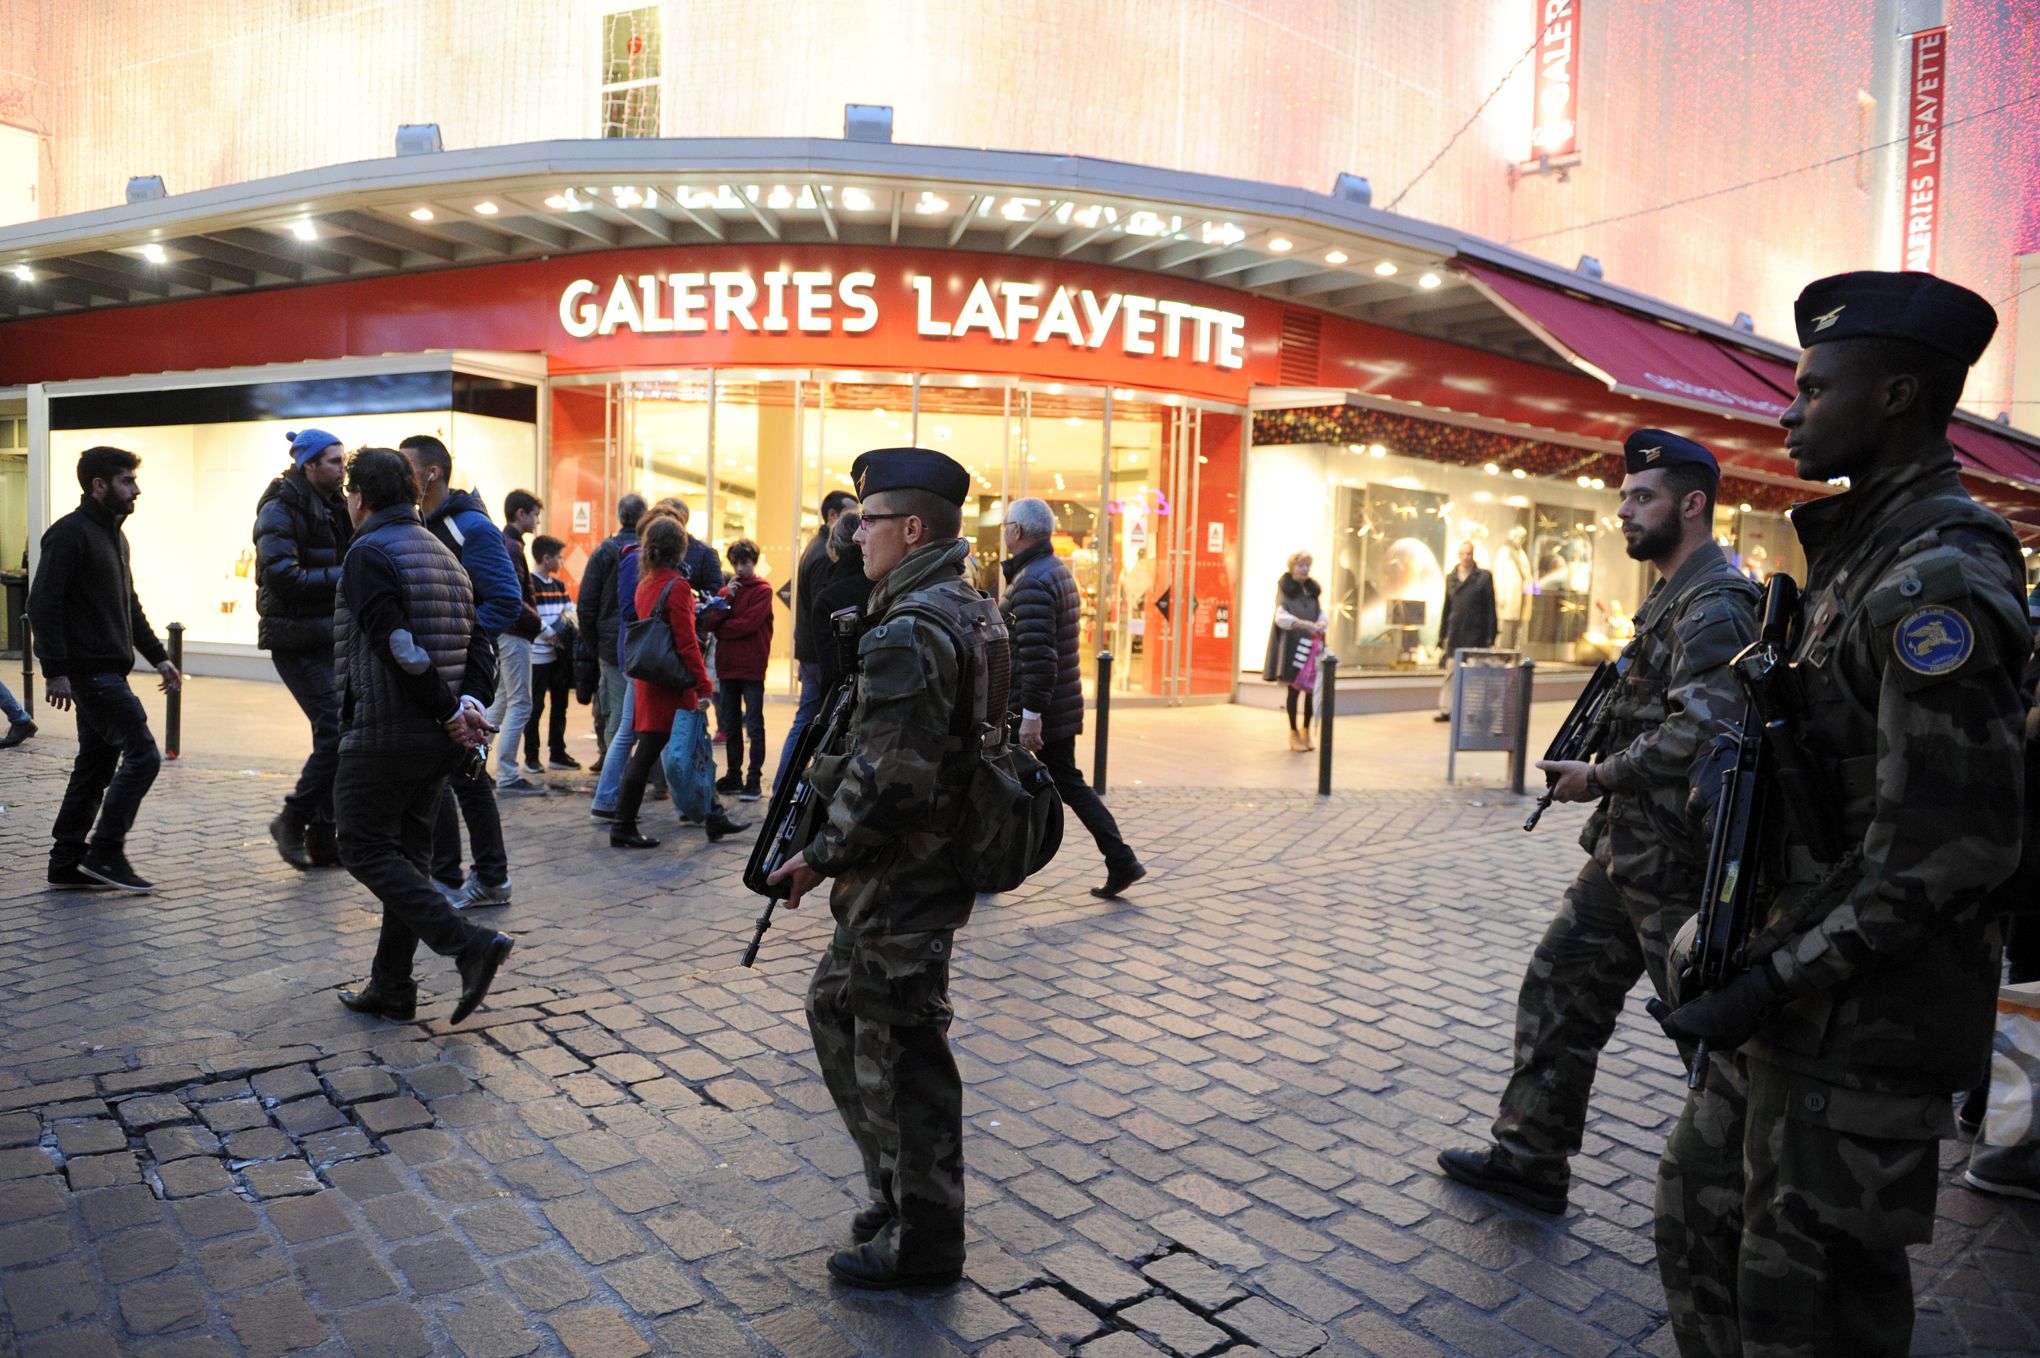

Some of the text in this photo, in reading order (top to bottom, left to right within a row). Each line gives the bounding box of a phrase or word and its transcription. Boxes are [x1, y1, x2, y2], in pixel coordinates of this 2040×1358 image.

[1912, 34, 1941, 169] LAFAYETTE
[558, 271, 1246, 369] GALERIES LAFAYETTE
